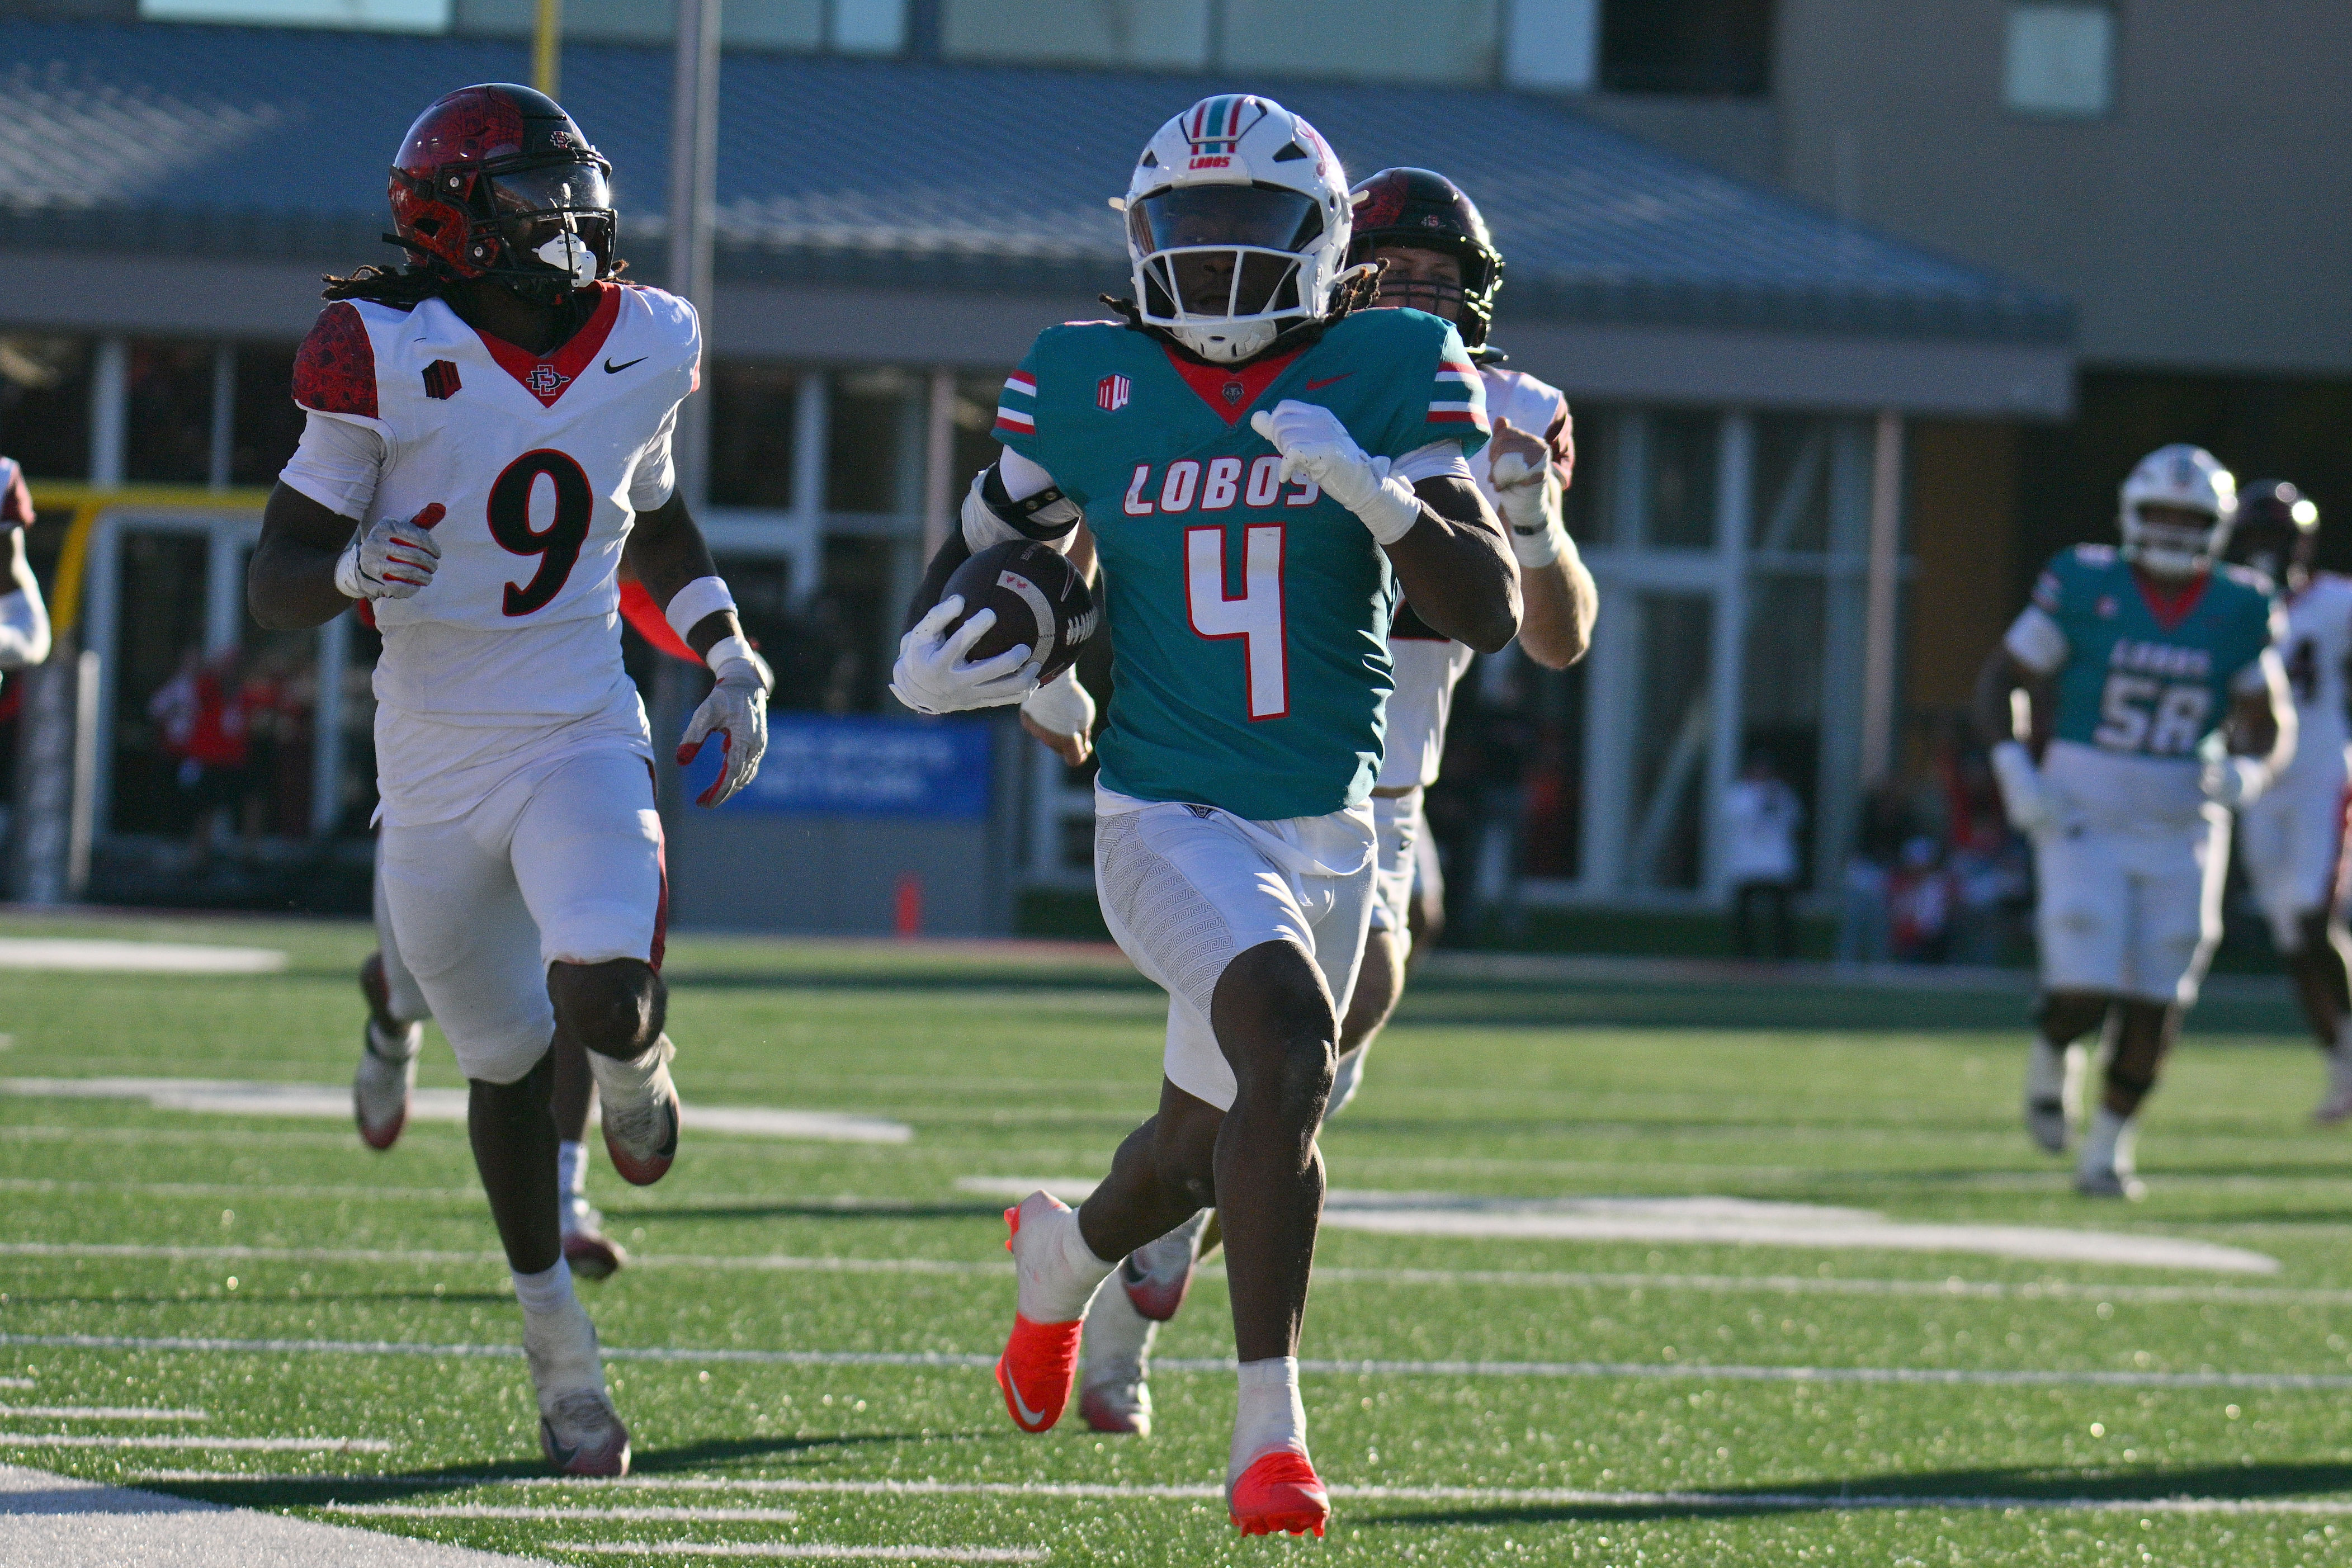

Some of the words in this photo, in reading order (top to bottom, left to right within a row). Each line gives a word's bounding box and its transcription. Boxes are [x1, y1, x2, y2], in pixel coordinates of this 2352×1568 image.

[1188, 157, 1230, 169] LOBOS
[486, 448, 593, 616] 9
[1123, 454, 1321, 516] LOBOS
[1183, 522, 1290, 722] 4
